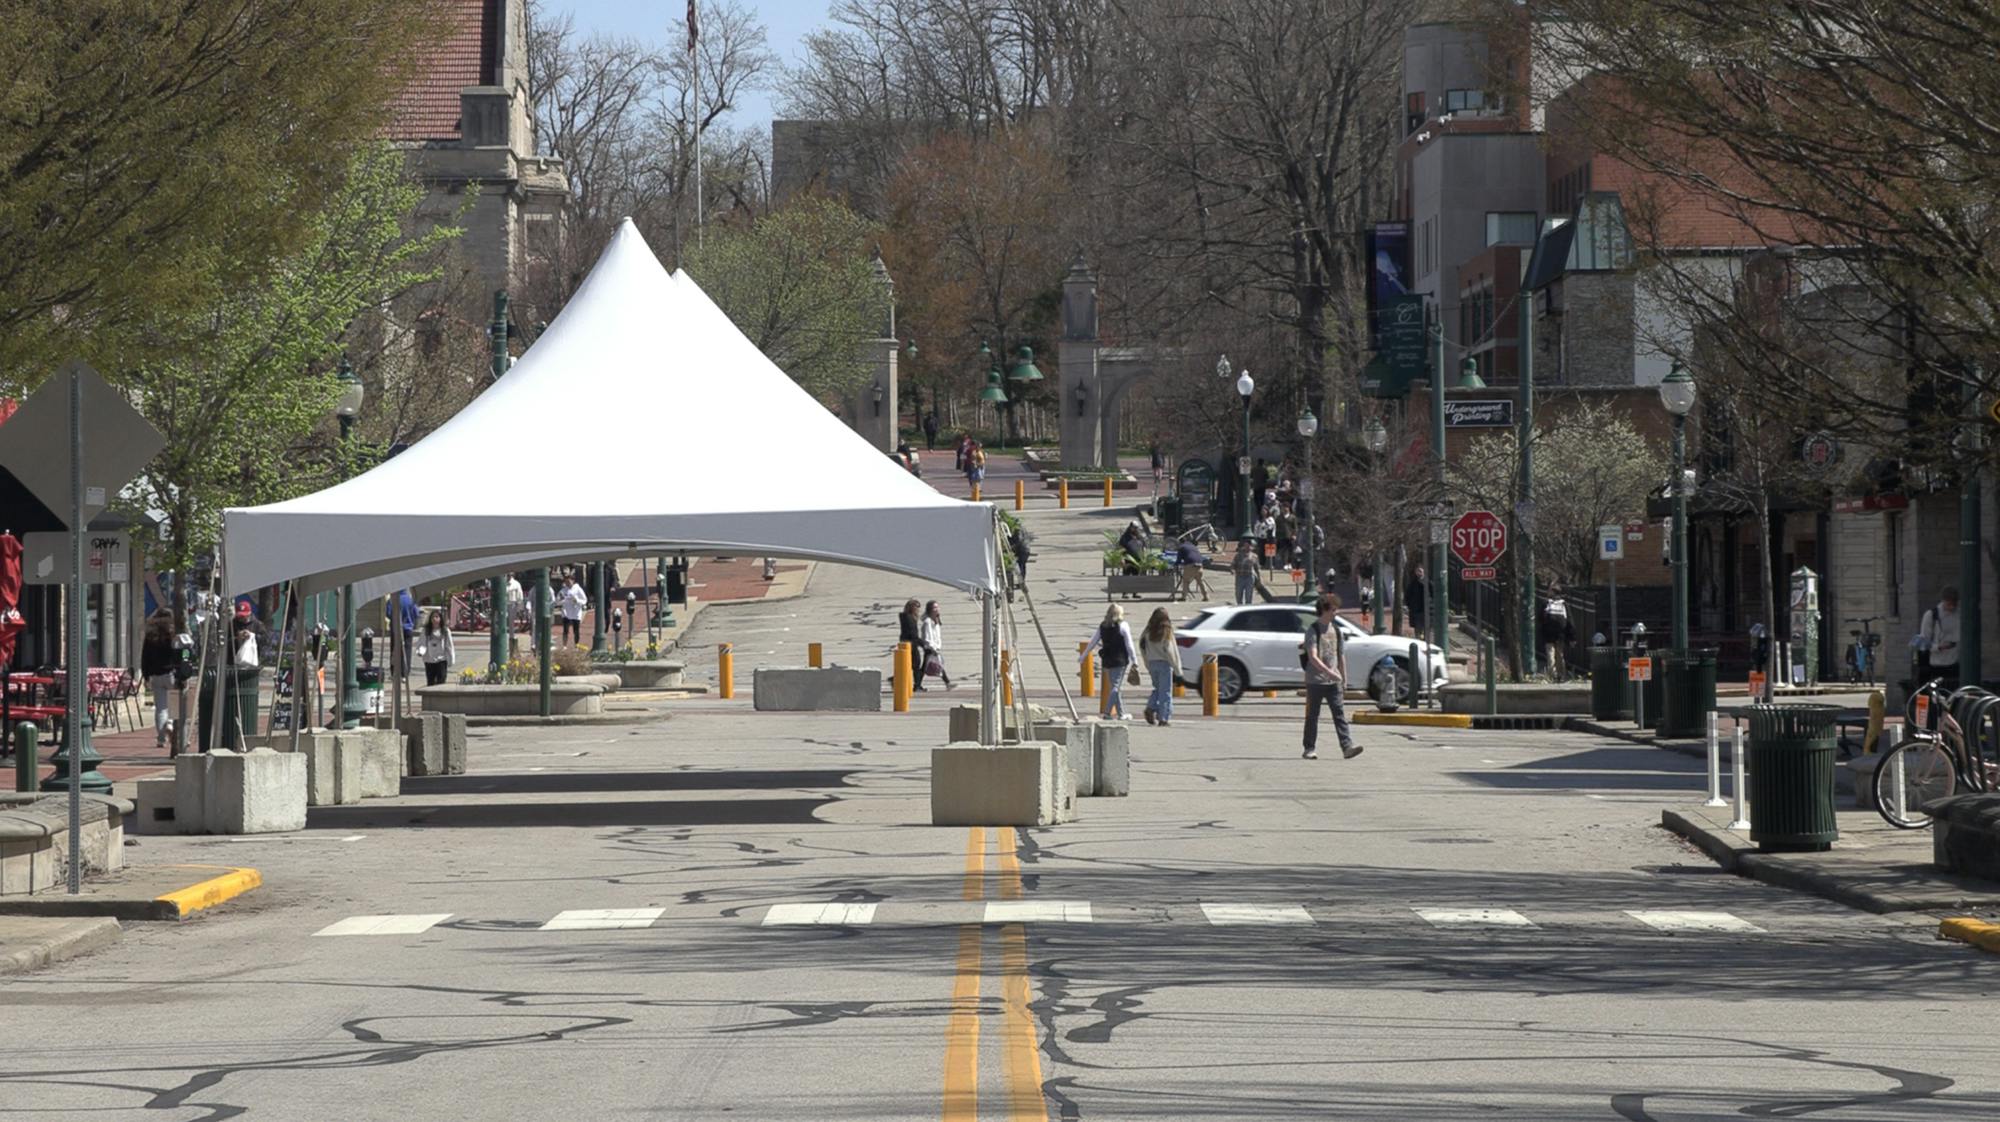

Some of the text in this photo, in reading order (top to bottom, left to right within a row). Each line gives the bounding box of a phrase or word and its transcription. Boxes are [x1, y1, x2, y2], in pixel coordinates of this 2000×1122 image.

[1443, 403, 1503, 414] Underground
[1452, 413, 1491, 424] Printing
[1455, 528, 1502, 548] STOP
